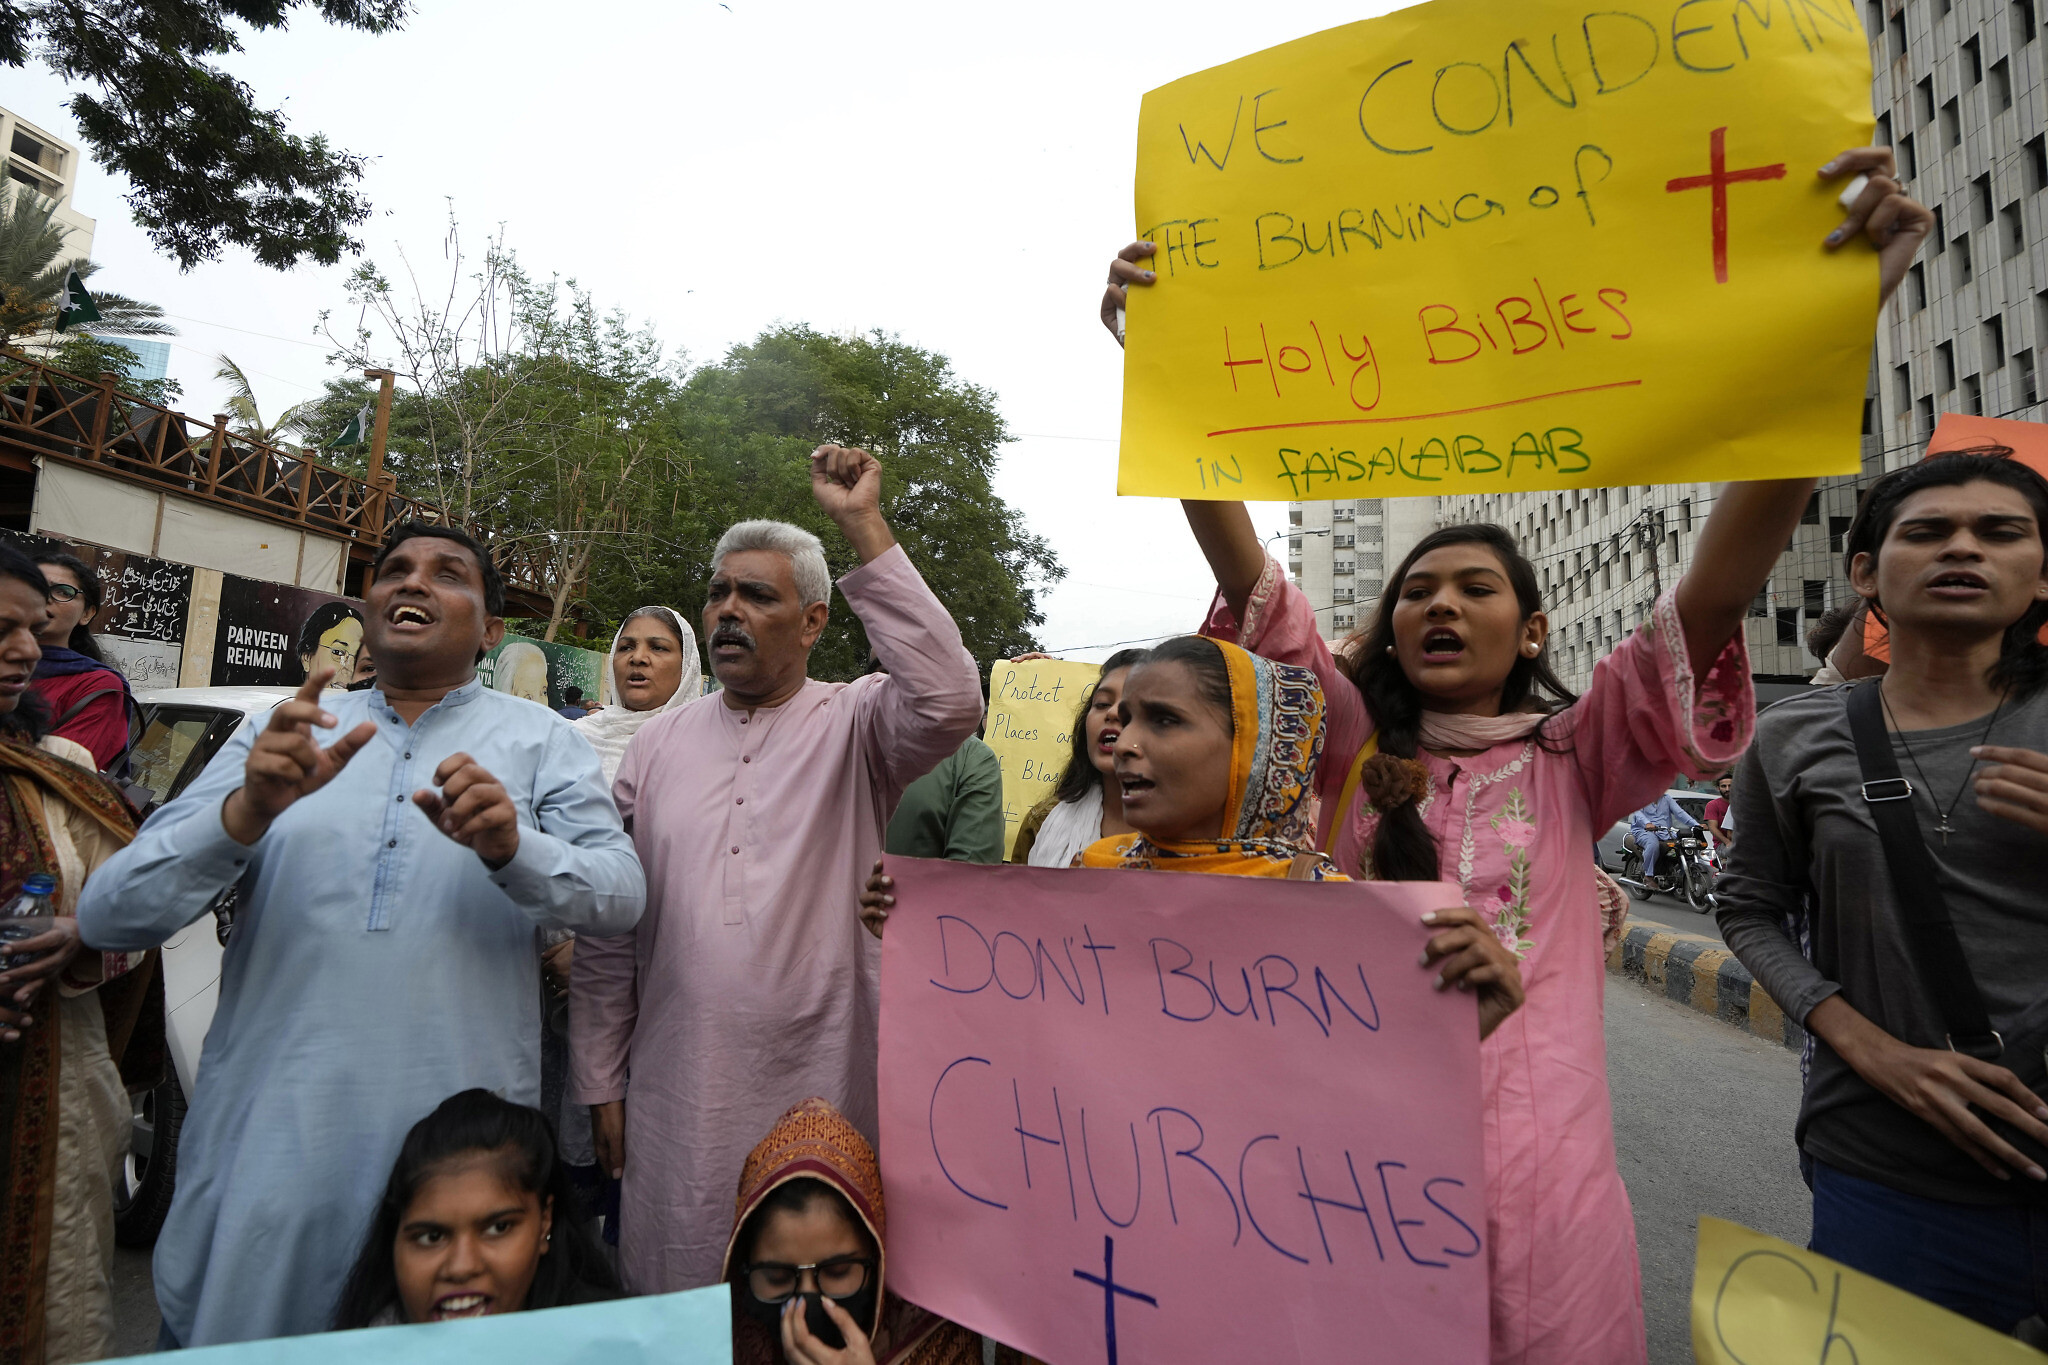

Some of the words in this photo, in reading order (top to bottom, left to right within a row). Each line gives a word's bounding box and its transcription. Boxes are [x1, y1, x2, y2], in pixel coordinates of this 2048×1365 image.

[1179, 89, 1304, 170] WE
[1143, 218, 1220, 277] THE
[226, 646, 283, 670] REHMAN
[227, 625, 288, 651] PARVEEN
[999, 670, 1064, 702] Protect
[991, 713, 1038, 741] Places
[1149, 937, 1380, 1038] BURN
[930, 1056, 1482, 1268] CHURCHES
